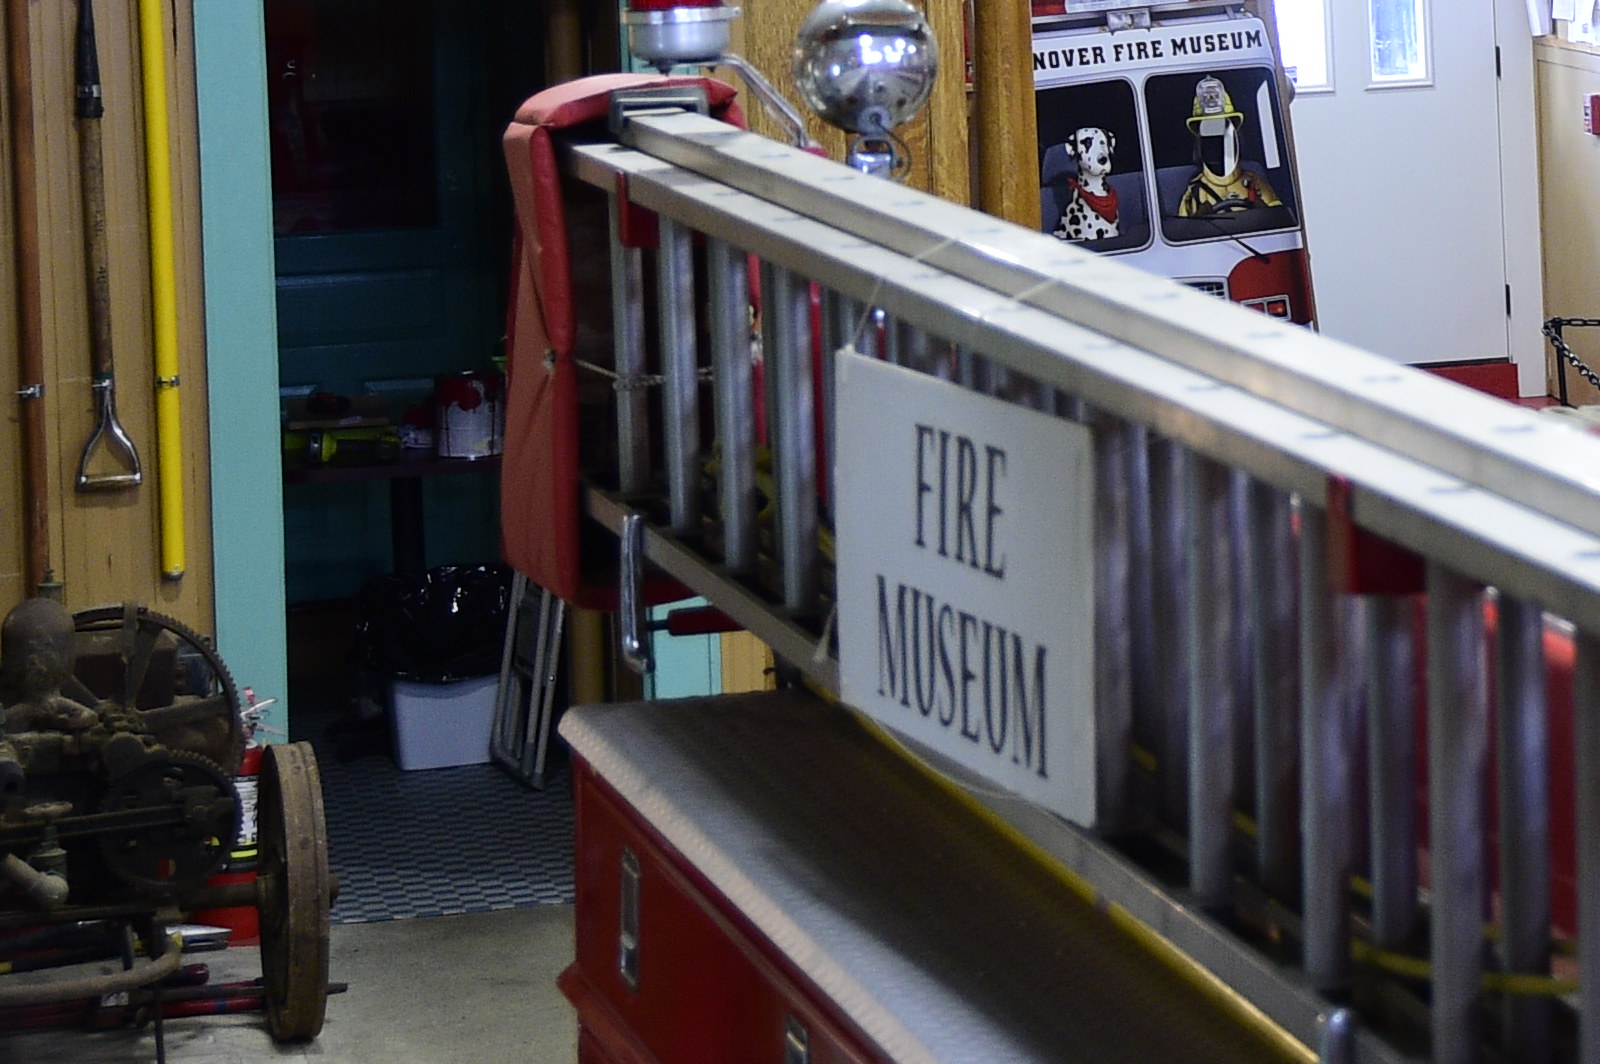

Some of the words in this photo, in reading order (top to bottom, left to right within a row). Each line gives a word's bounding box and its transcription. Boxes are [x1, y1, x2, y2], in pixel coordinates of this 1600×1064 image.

[1033, 46, 1106, 71] NOVER
[1113, 39, 1164, 62] FIRE
[1170, 29, 1263, 56] MUSEUM
[915, 423, 1008, 580] FIRE
[876, 573, 1049, 779] MUSEUM
